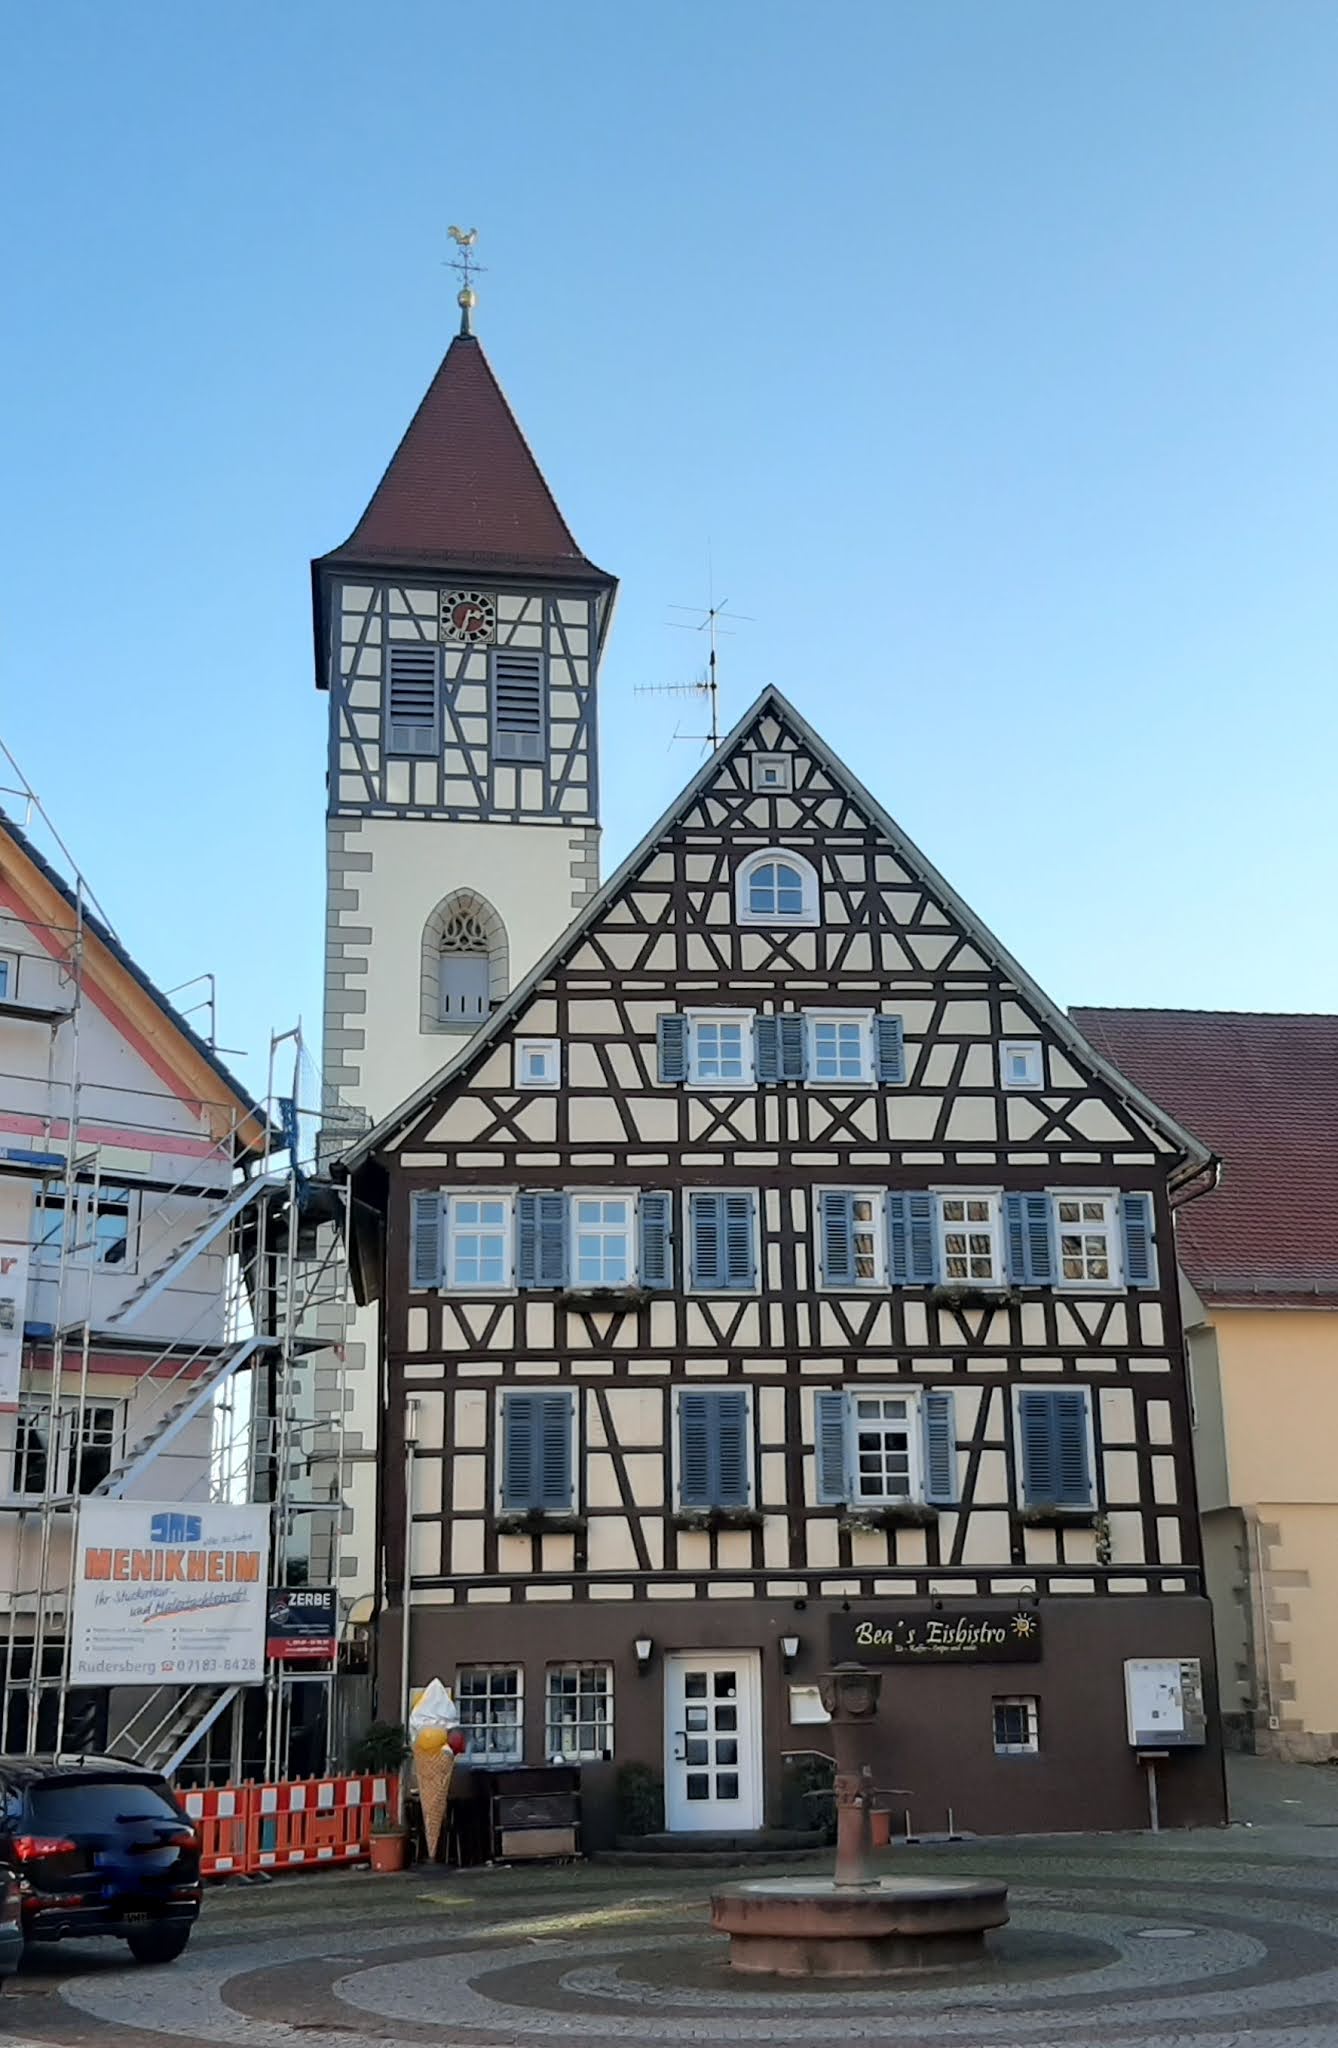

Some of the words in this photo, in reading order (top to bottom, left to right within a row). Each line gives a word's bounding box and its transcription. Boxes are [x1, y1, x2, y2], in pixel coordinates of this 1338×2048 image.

[85, 1548, 260, 1582] MENIKHEIM
[288, 1593, 331, 1606] ZERBE
[926, 1617, 1006, 1644] Eisbistro
[78, 1660, 156, 1675] Rudersberg
